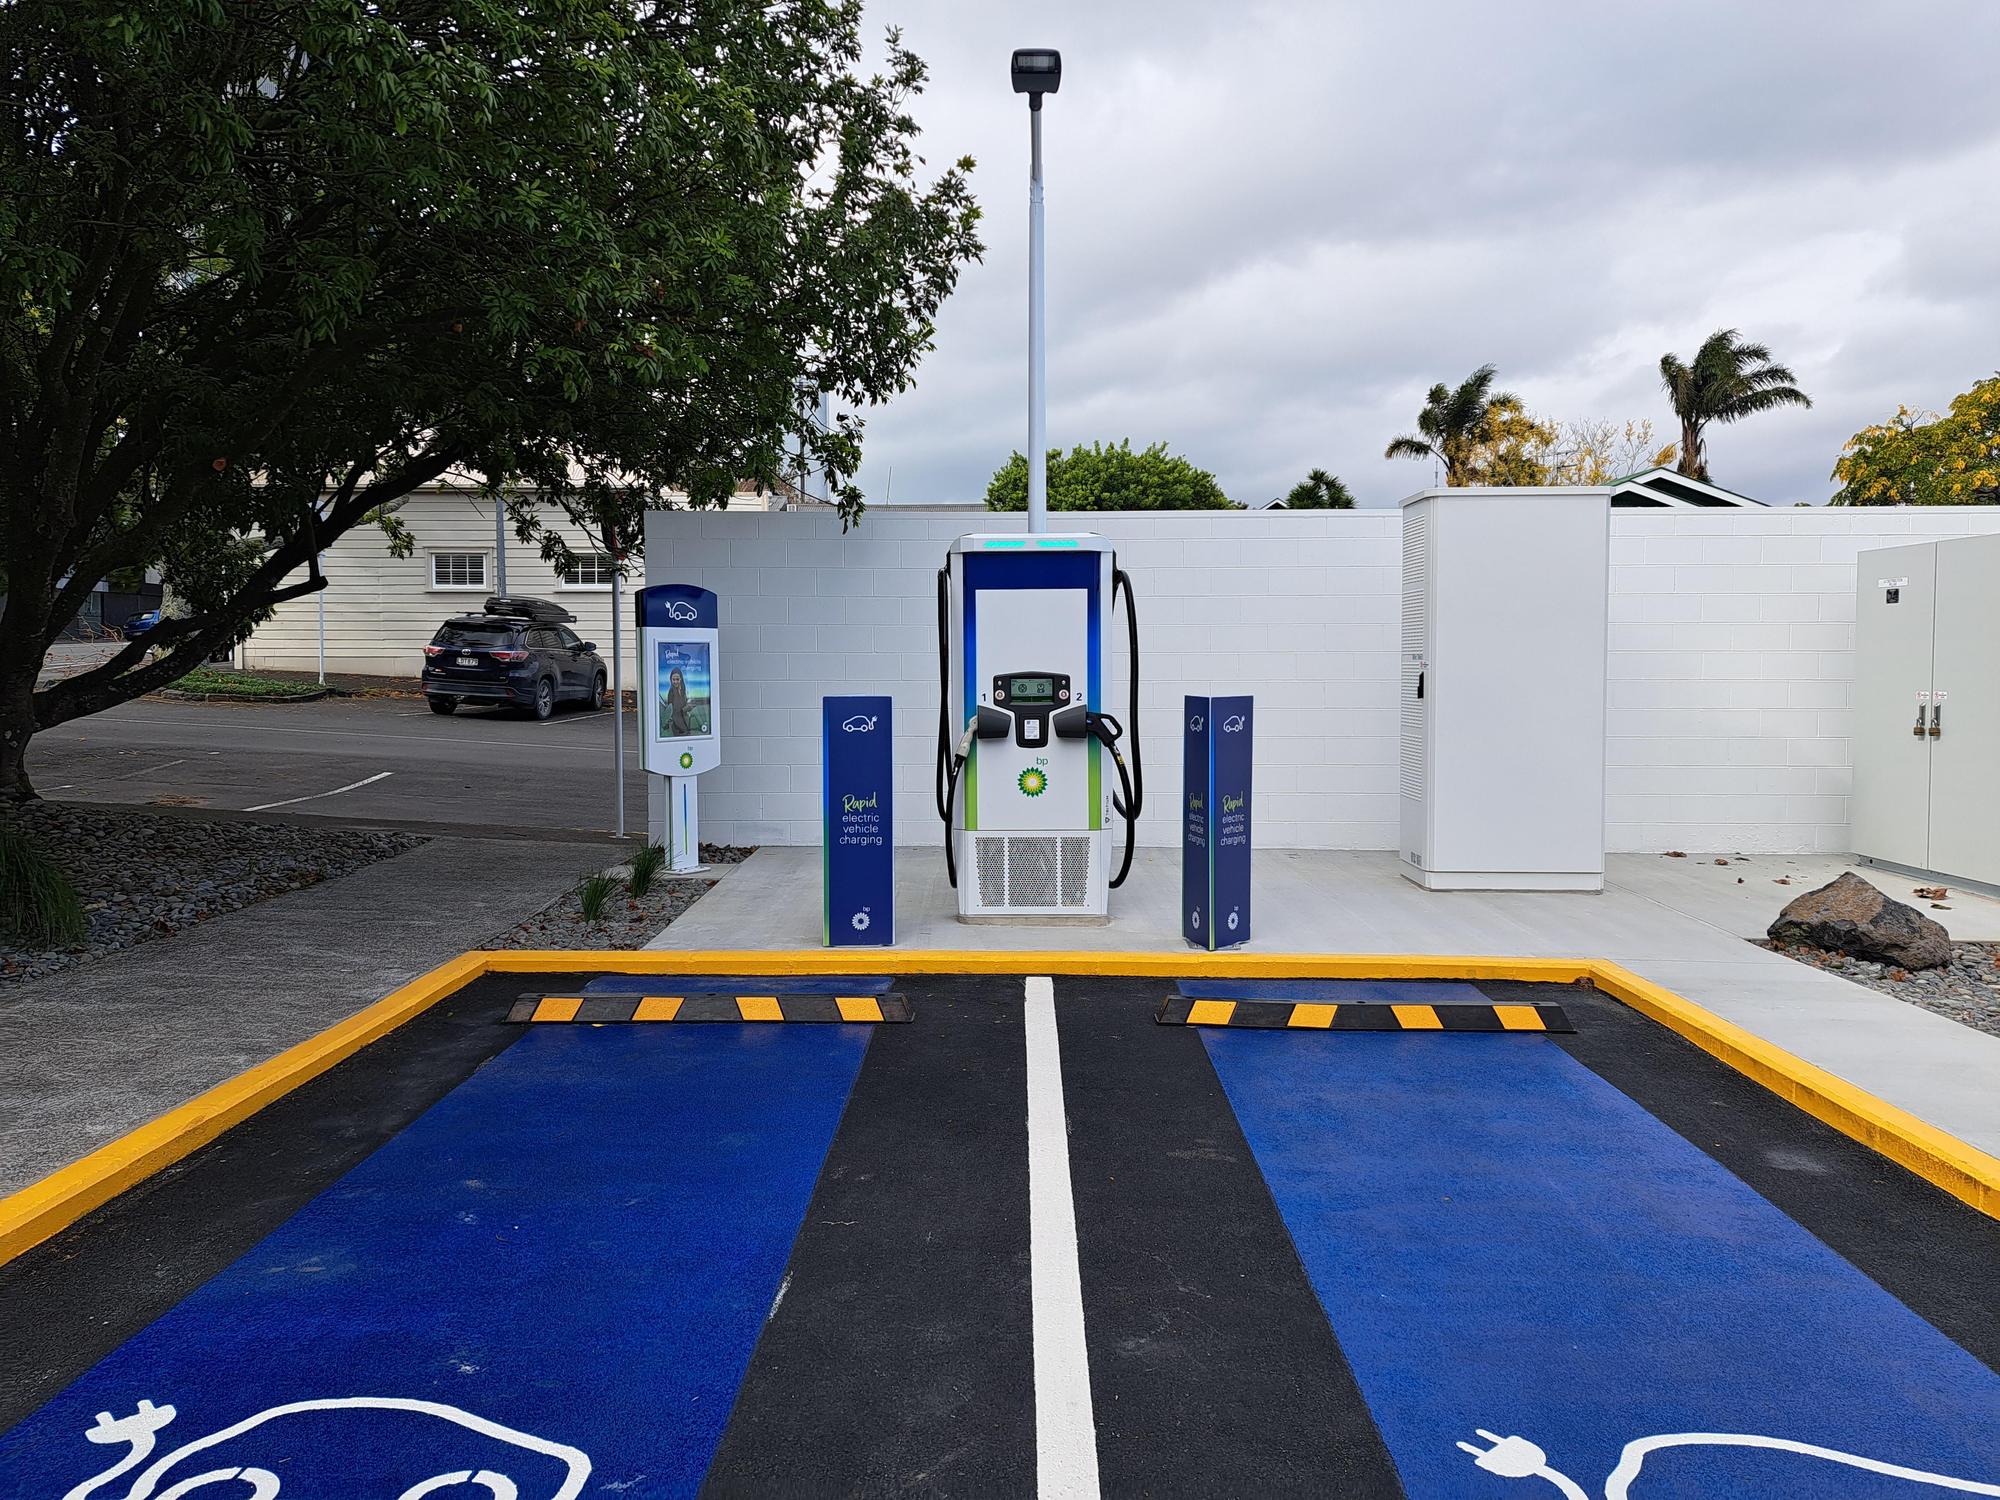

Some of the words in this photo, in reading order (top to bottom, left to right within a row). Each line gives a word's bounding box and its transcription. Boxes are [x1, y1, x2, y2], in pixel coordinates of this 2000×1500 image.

[982, 693, 987, 702] 1
[1076, 692, 1083, 702] 2
[1036, 757, 1048, 766] bp
[842, 791, 877, 813] Rapid
[1222, 790, 1244, 813] Rapid
[842, 813, 880, 823] electric
[1222, 813, 1245, 824] electric
[842, 824, 879, 834] vehicle
[1222, 823, 1244, 835] vehicle
[839, 834, 883, 846] charging
[1220, 835, 1246, 846] charging
